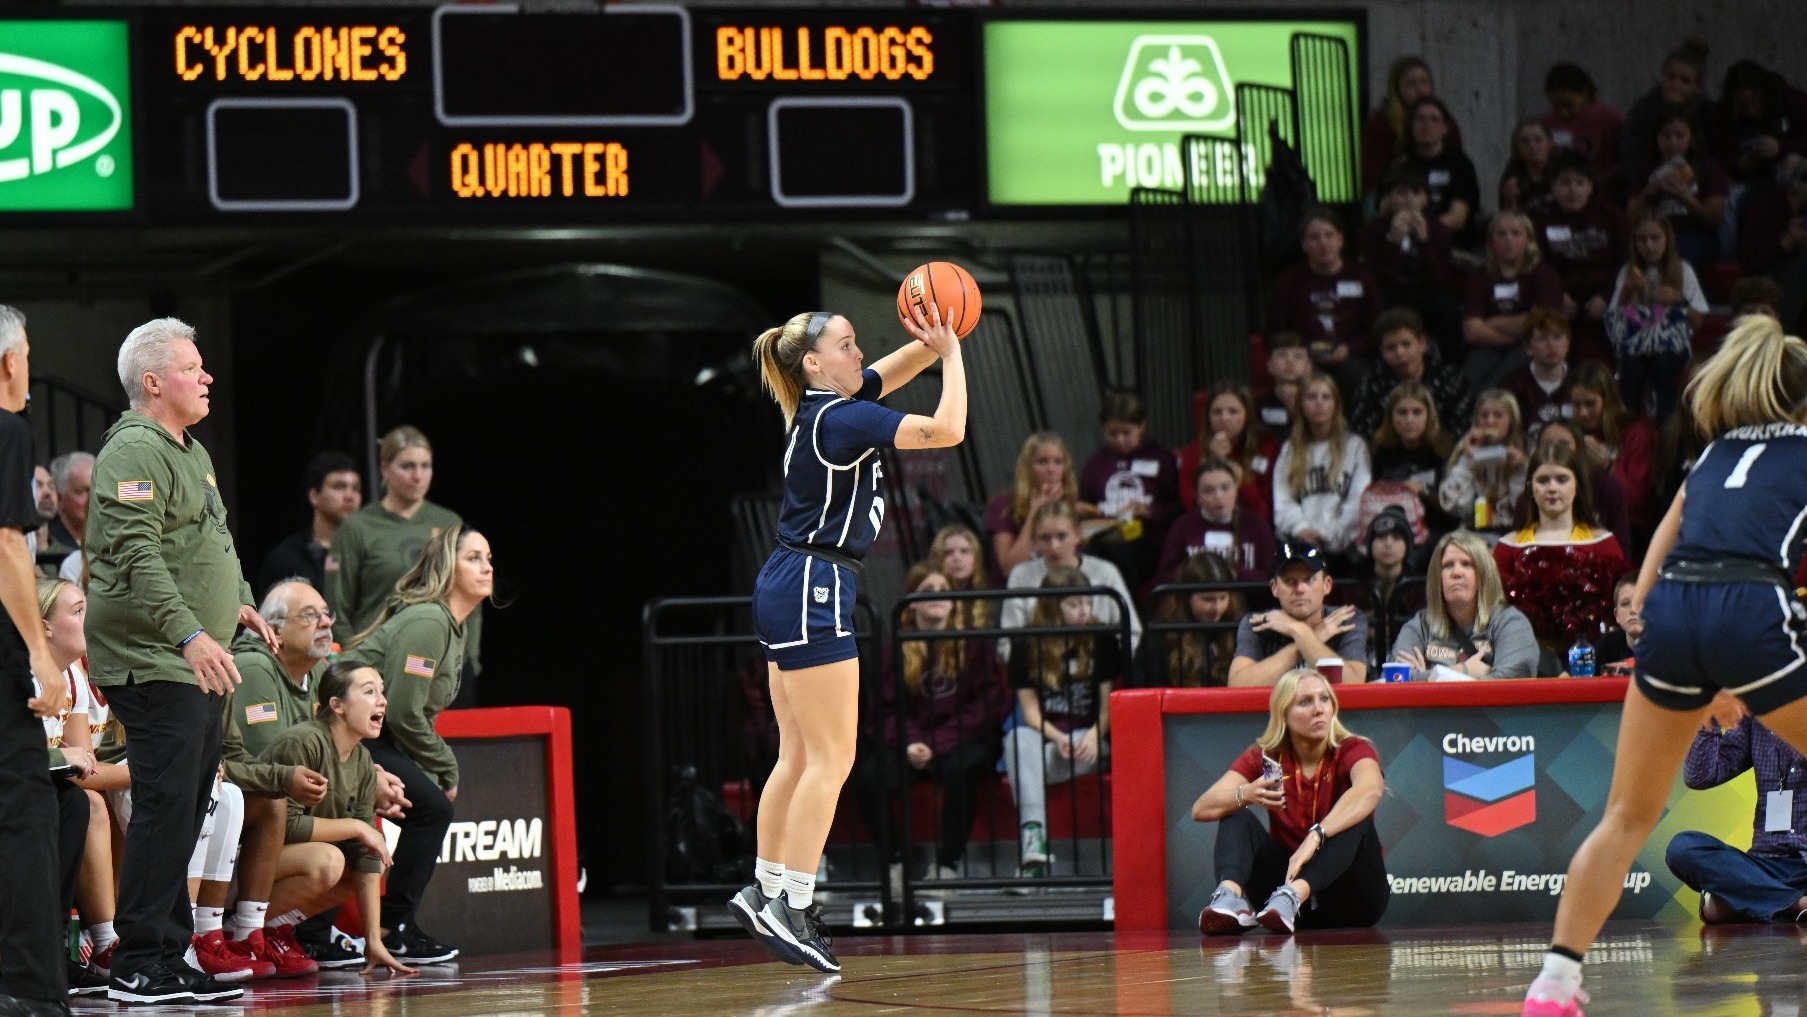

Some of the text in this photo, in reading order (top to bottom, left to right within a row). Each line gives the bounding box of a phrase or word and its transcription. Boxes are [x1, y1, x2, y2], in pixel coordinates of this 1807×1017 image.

[175, 26, 407, 81] CYCLONES
[716, 27, 934, 81] BULLDOGS
[450, 143, 629, 198] QUARTER
[1723, 443, 1767, 489] 1
[1442, 732, 1535, 754] Chevron
[436, 818, 543, 863] TREAM
